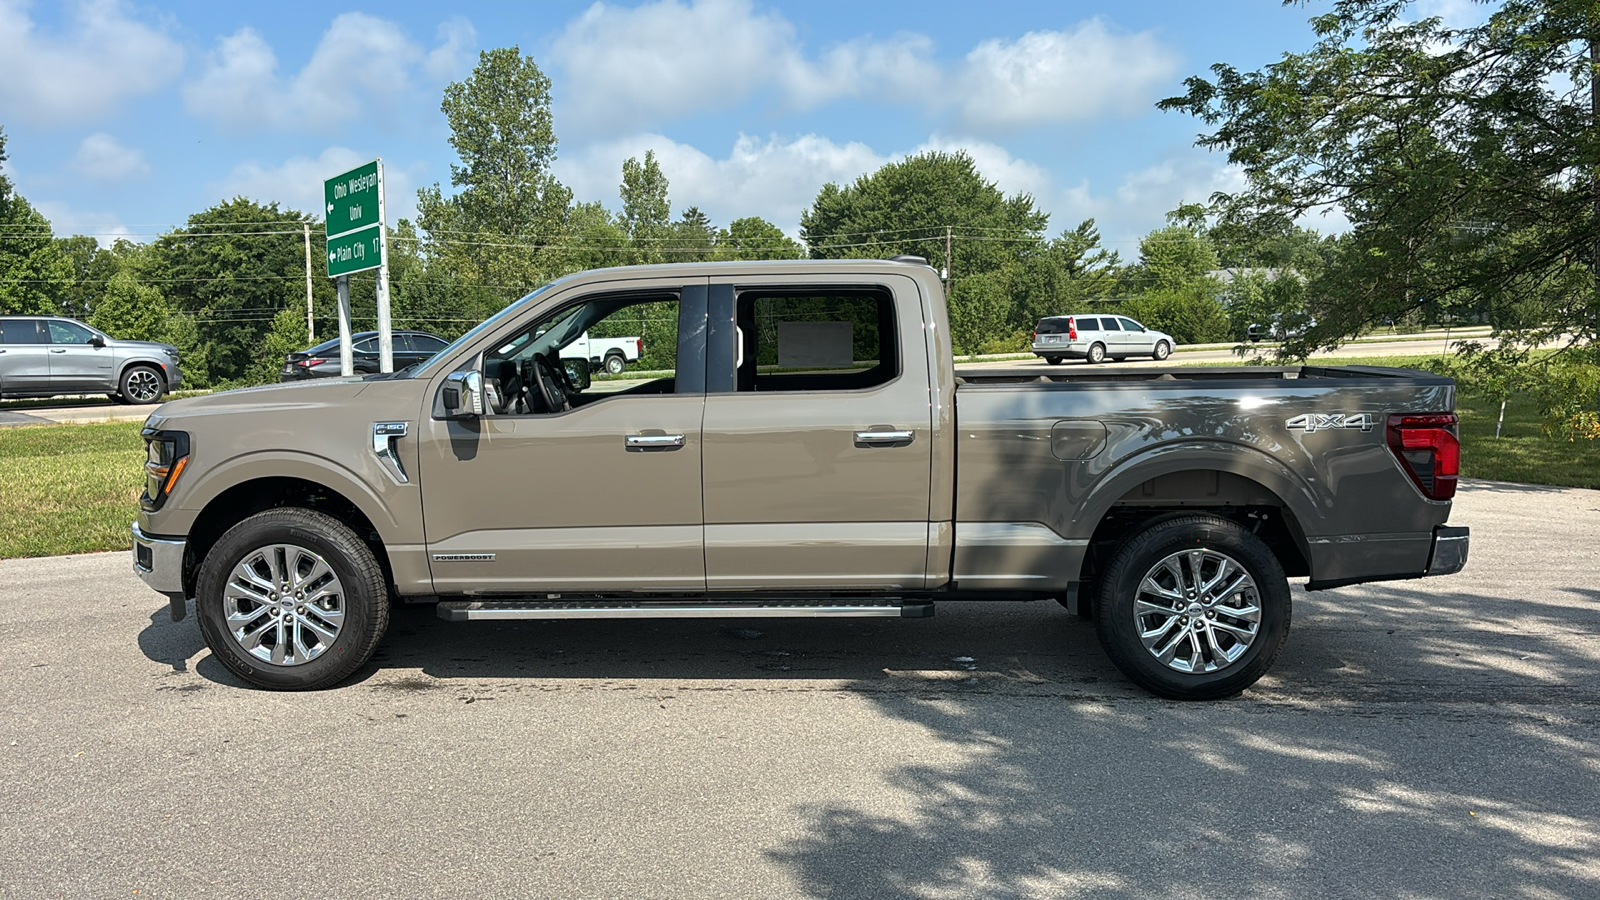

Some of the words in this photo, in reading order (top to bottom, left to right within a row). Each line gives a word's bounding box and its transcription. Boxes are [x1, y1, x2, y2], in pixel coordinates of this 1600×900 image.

[334, 182, 347, 200] Ohio
[349, 172, 377, 194] Wesleyan
[349, 203, 362, 221] Univ
[337, 245, 352, 262] Plain
[353, 242, 365, 260] City
[372, 237, 379, 253] 17
